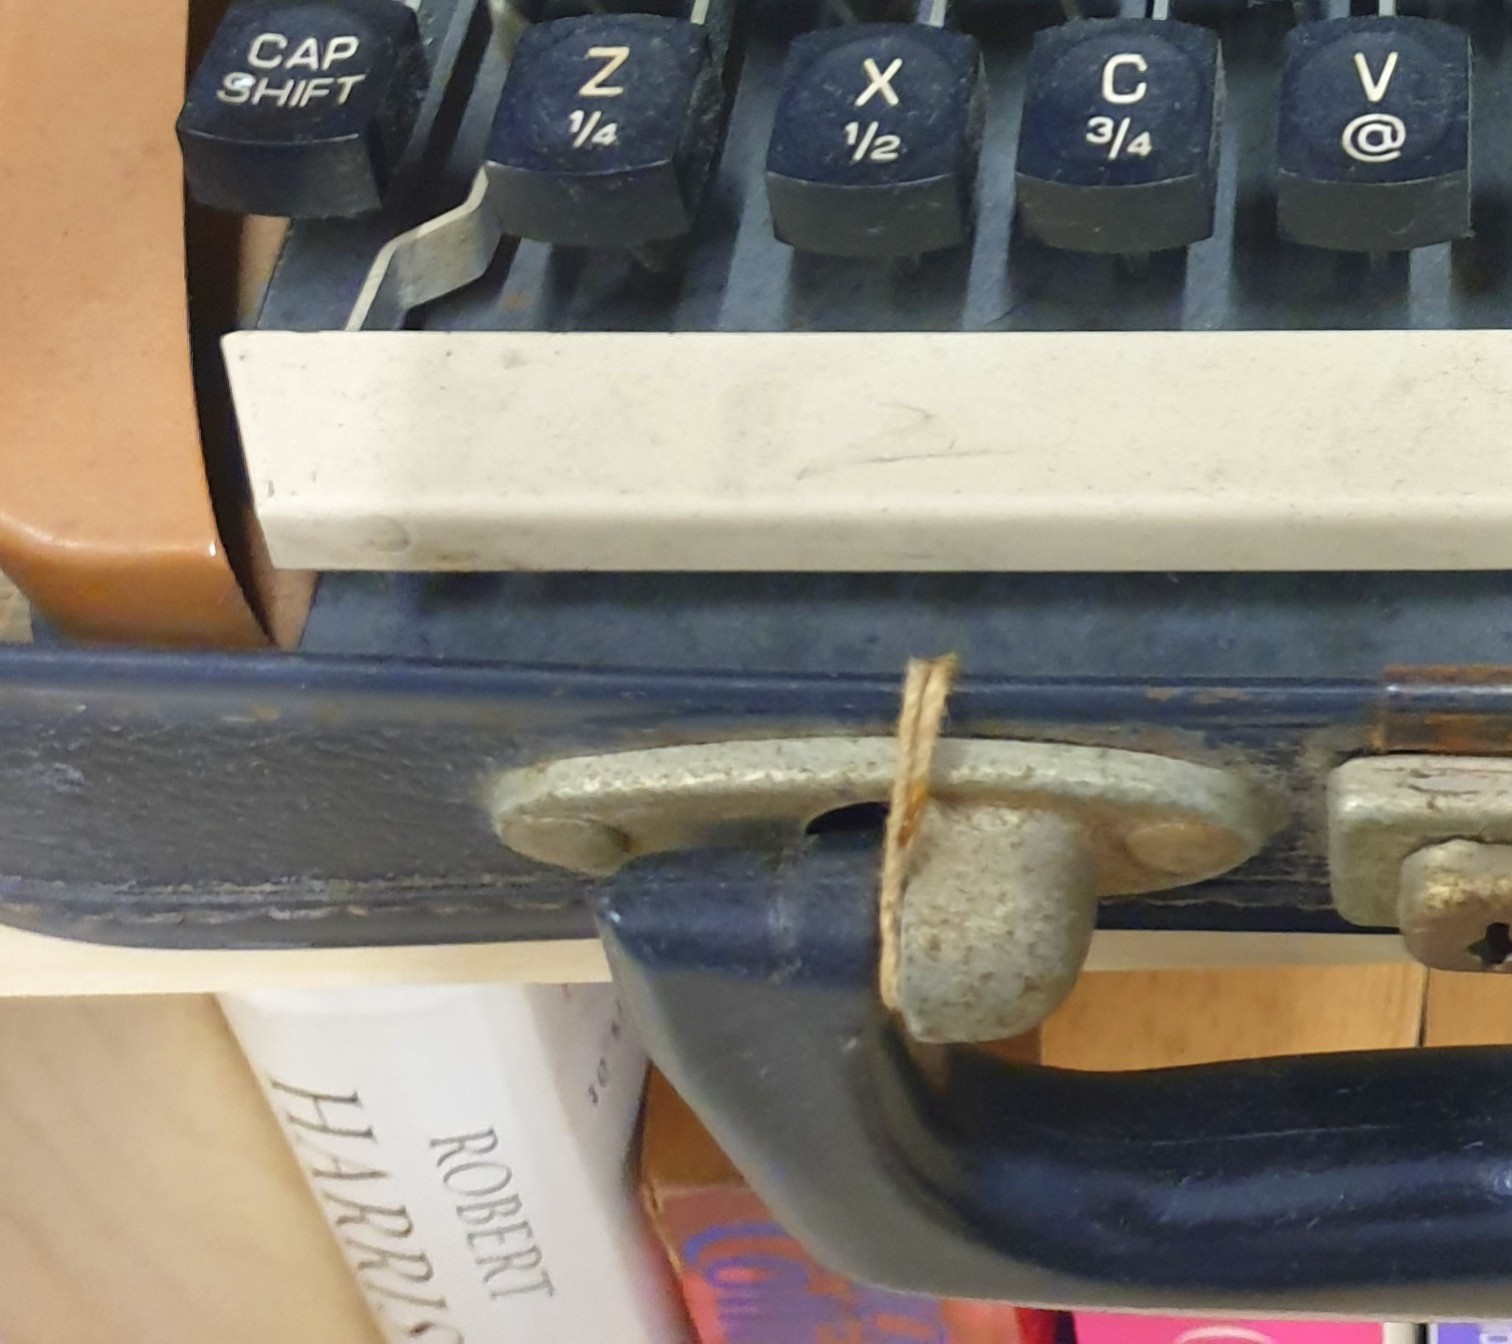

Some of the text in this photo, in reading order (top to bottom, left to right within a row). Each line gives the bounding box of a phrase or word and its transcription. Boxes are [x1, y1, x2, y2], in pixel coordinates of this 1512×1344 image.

[247, 32, 359, 71] CAP
[578, 46, 630, 96] Z
[216, 72, 367, 108] SHIFT
[855, 58, 903, 107] X
[1102, 53, 1148, 104] C
[1354, 51, 1398, 102] V
[1342, 113, 1406, 162] @
[428, 1126, 556, 1301] ROBERT
